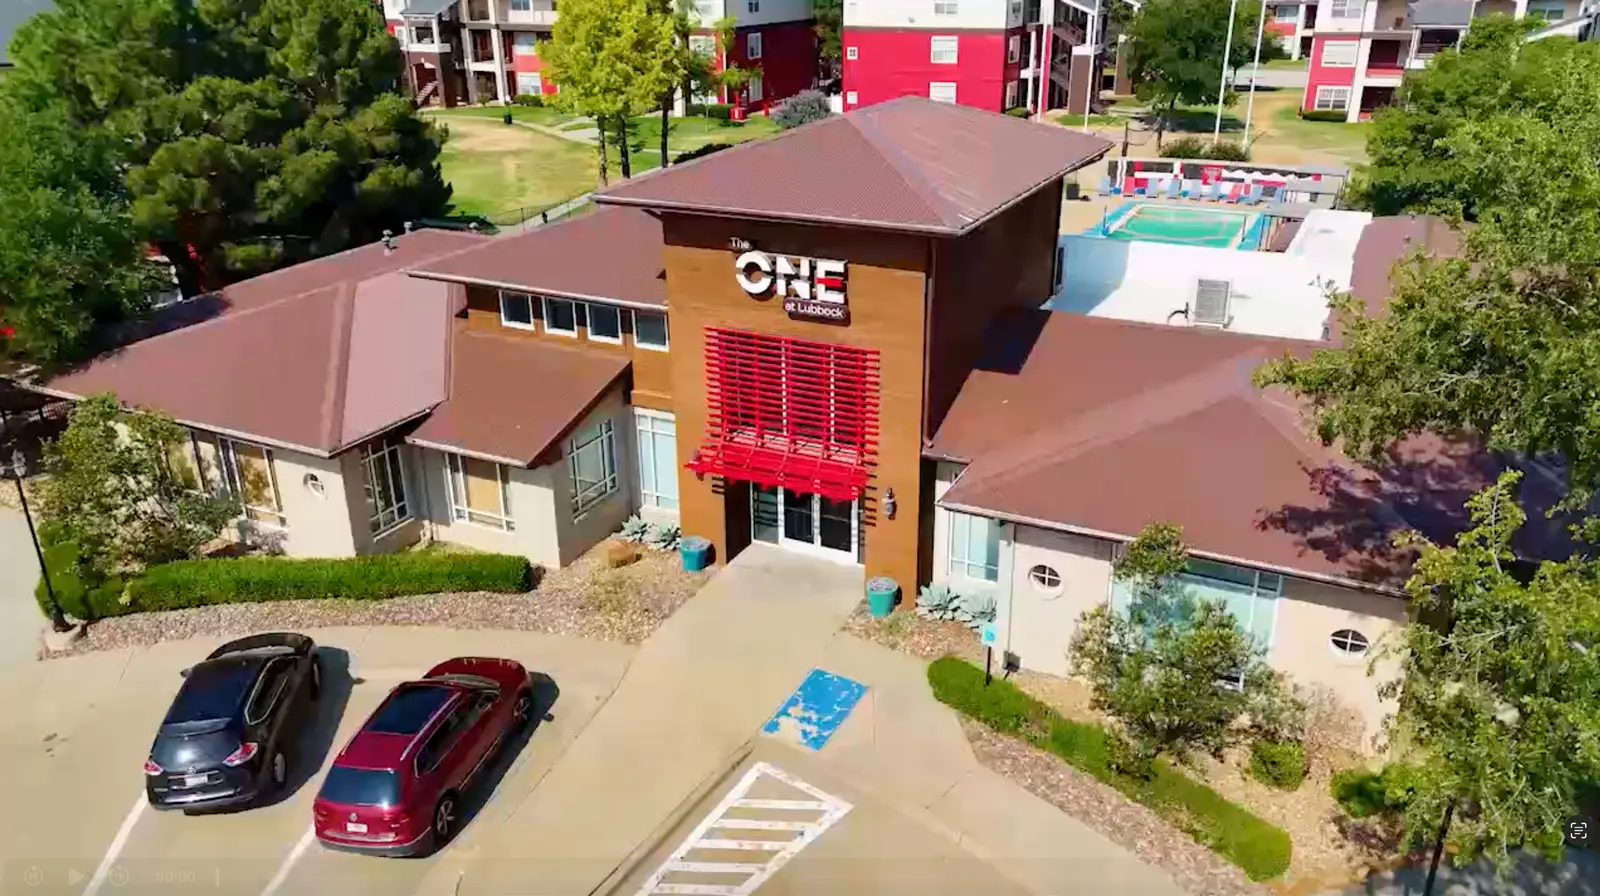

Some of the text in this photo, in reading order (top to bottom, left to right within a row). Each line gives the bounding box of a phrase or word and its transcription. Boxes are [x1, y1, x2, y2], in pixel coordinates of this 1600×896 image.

[730, 236, 751, 249] The
[735, 251, 847, 304] ONE
[785, 301, 844, 318] at Lubbock
